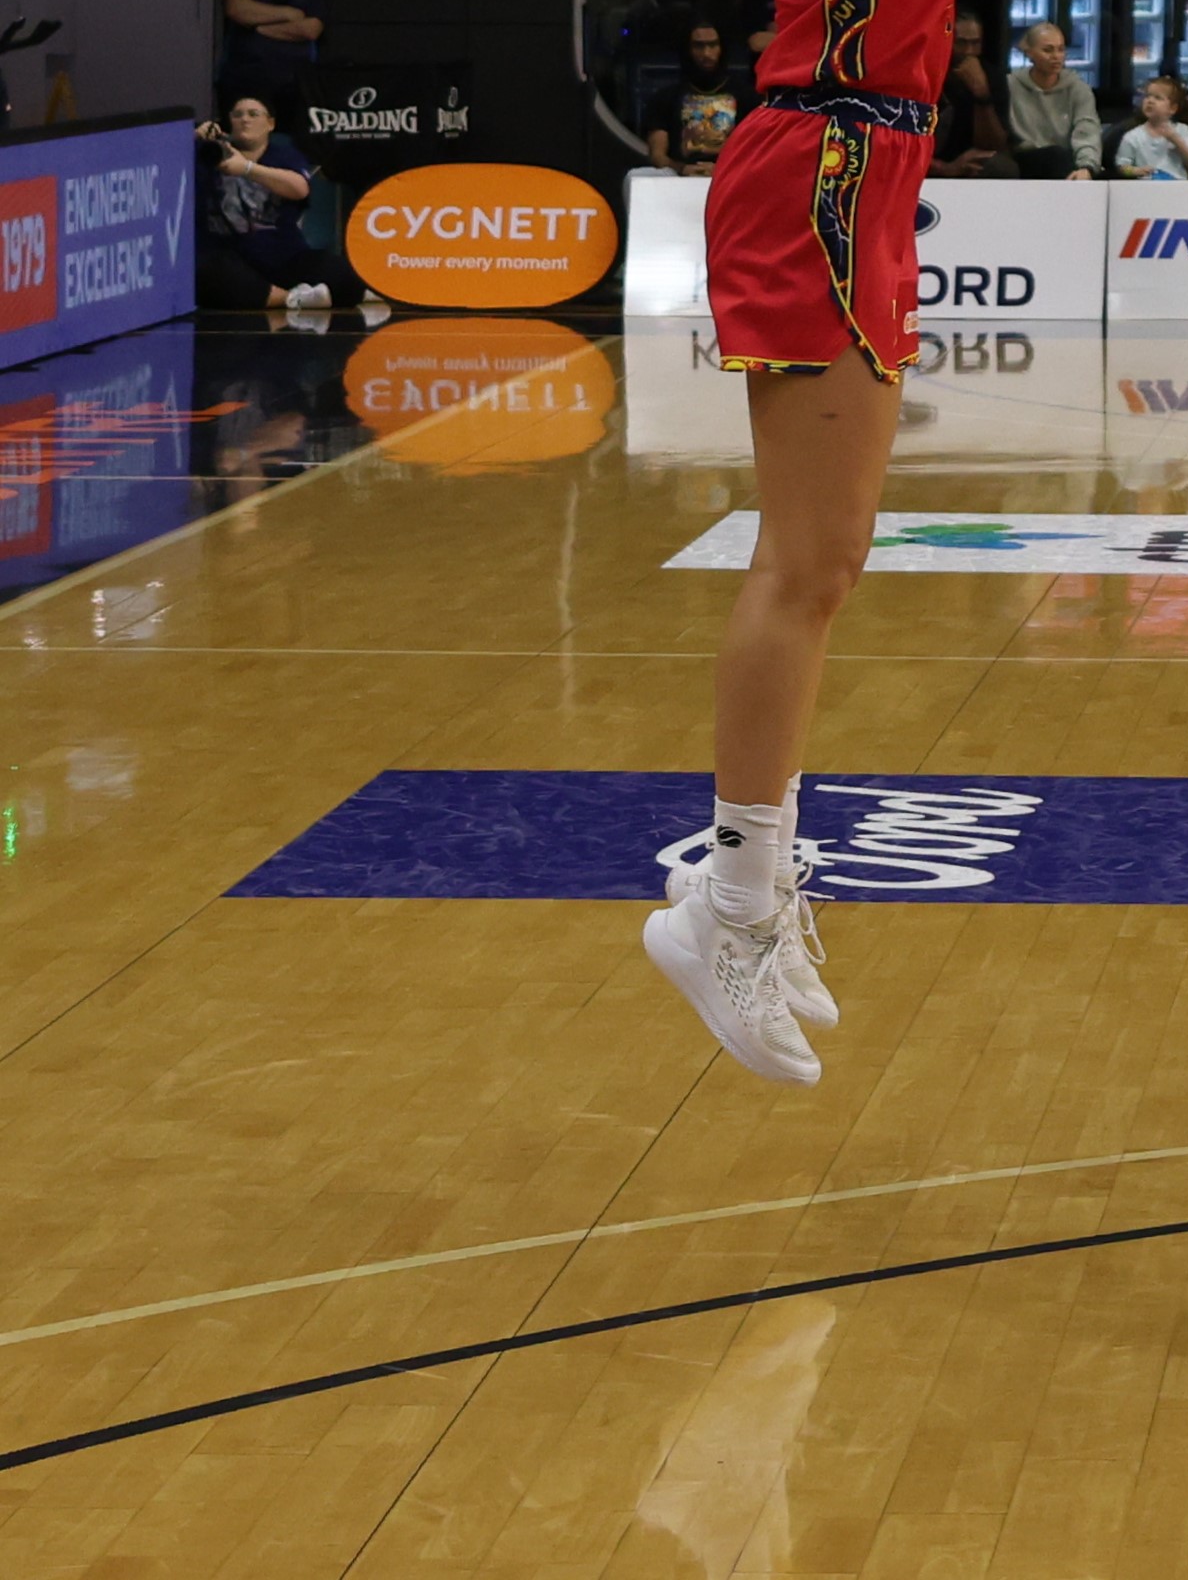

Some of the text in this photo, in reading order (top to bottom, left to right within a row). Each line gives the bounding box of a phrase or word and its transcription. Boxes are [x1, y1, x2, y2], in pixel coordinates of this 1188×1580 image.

[307, 105, 418, 133] SPALDING
[64, 164, 160, 235] ENGINEERING
[365, 205, 598, 241] CYGNETT
[0, 213, 46, 294] 1979
[64, 235, 154, 310] EXCELLENCE
[386, 253, 569, 274] Power every moment
